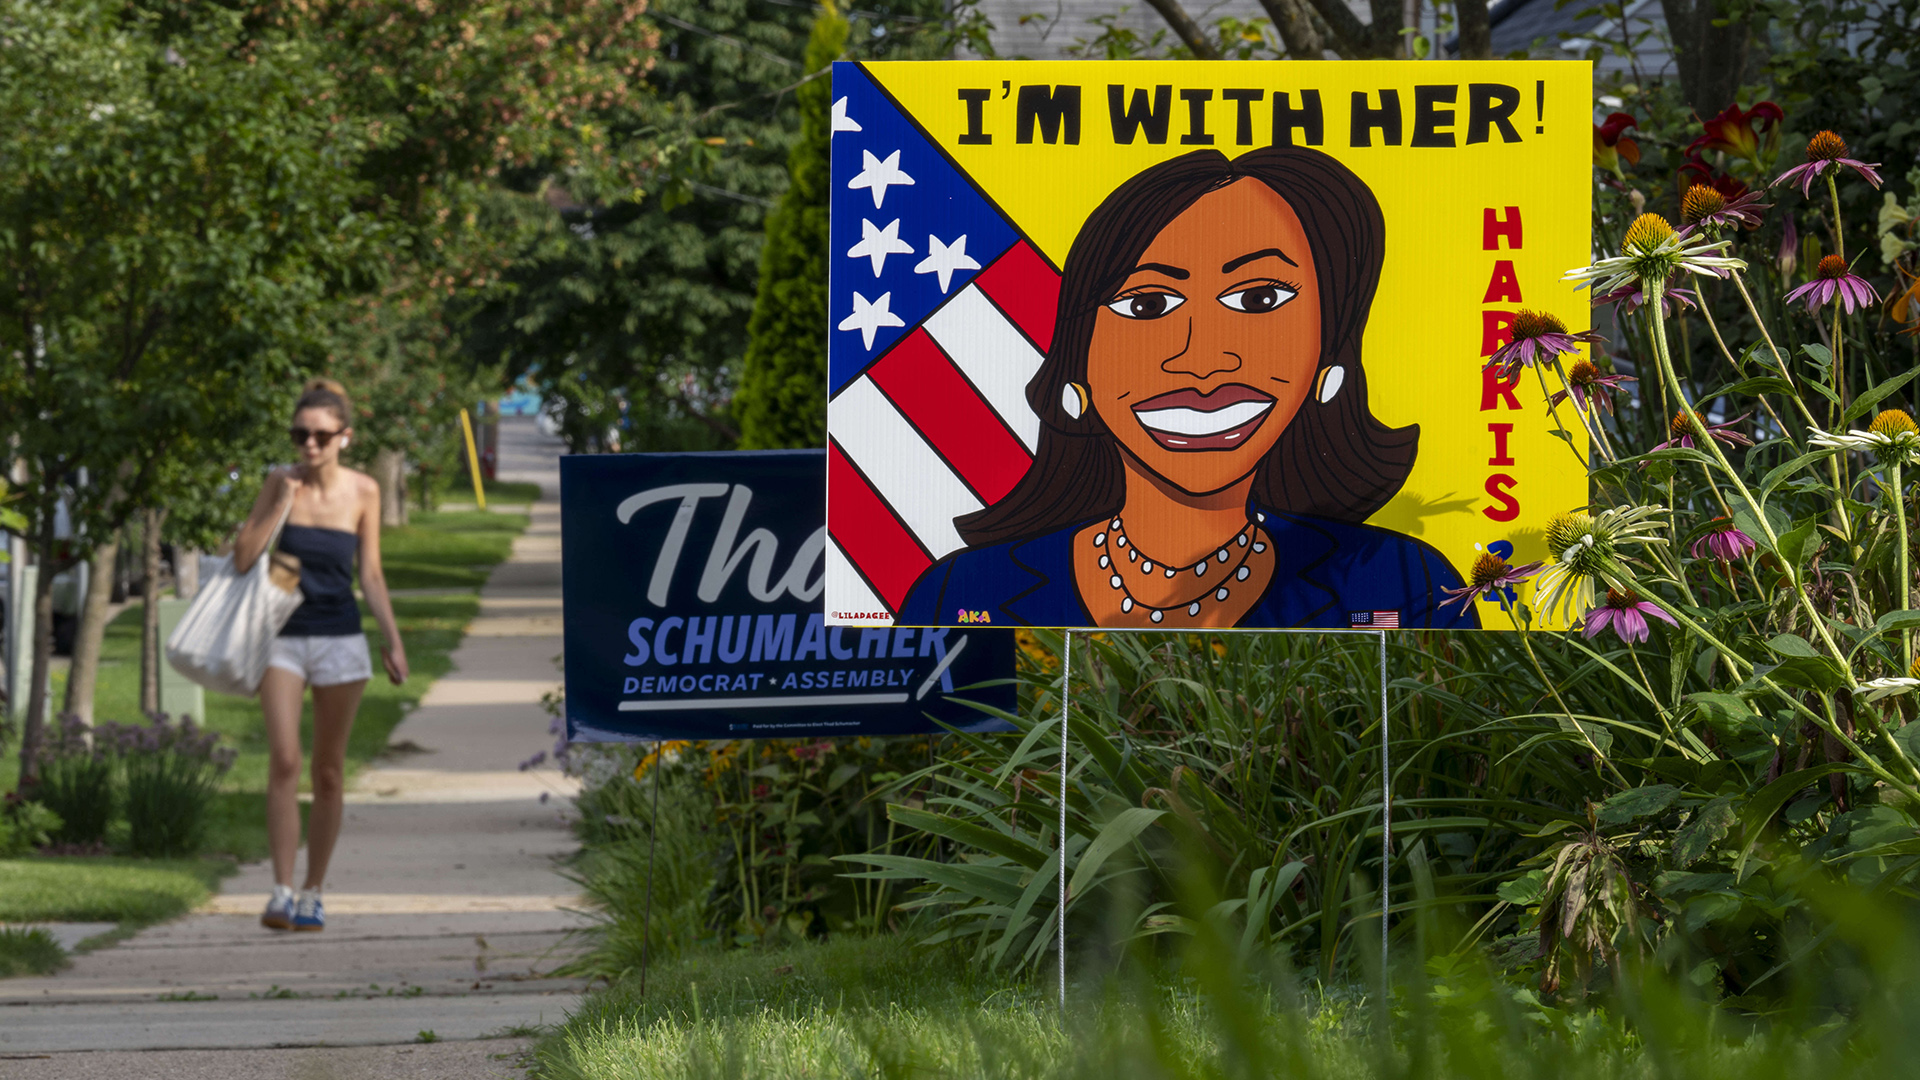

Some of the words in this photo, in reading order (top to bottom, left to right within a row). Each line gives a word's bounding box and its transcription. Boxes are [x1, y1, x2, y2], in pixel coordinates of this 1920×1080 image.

[957, 80, 1082, 146] I'M
[1106, 83, 1325, 146] WITH
[1350, 80, 1546, 148] HER!
[1480, 206, 1523, 522] HARRIS
[957, 609, 991, 623] AKA
[623, 613, 954, 693] SCHUMACHER
[623, 673, 764, 694] DEMOCRAT
[782, 669, 914, 690] ASSEMBLY
